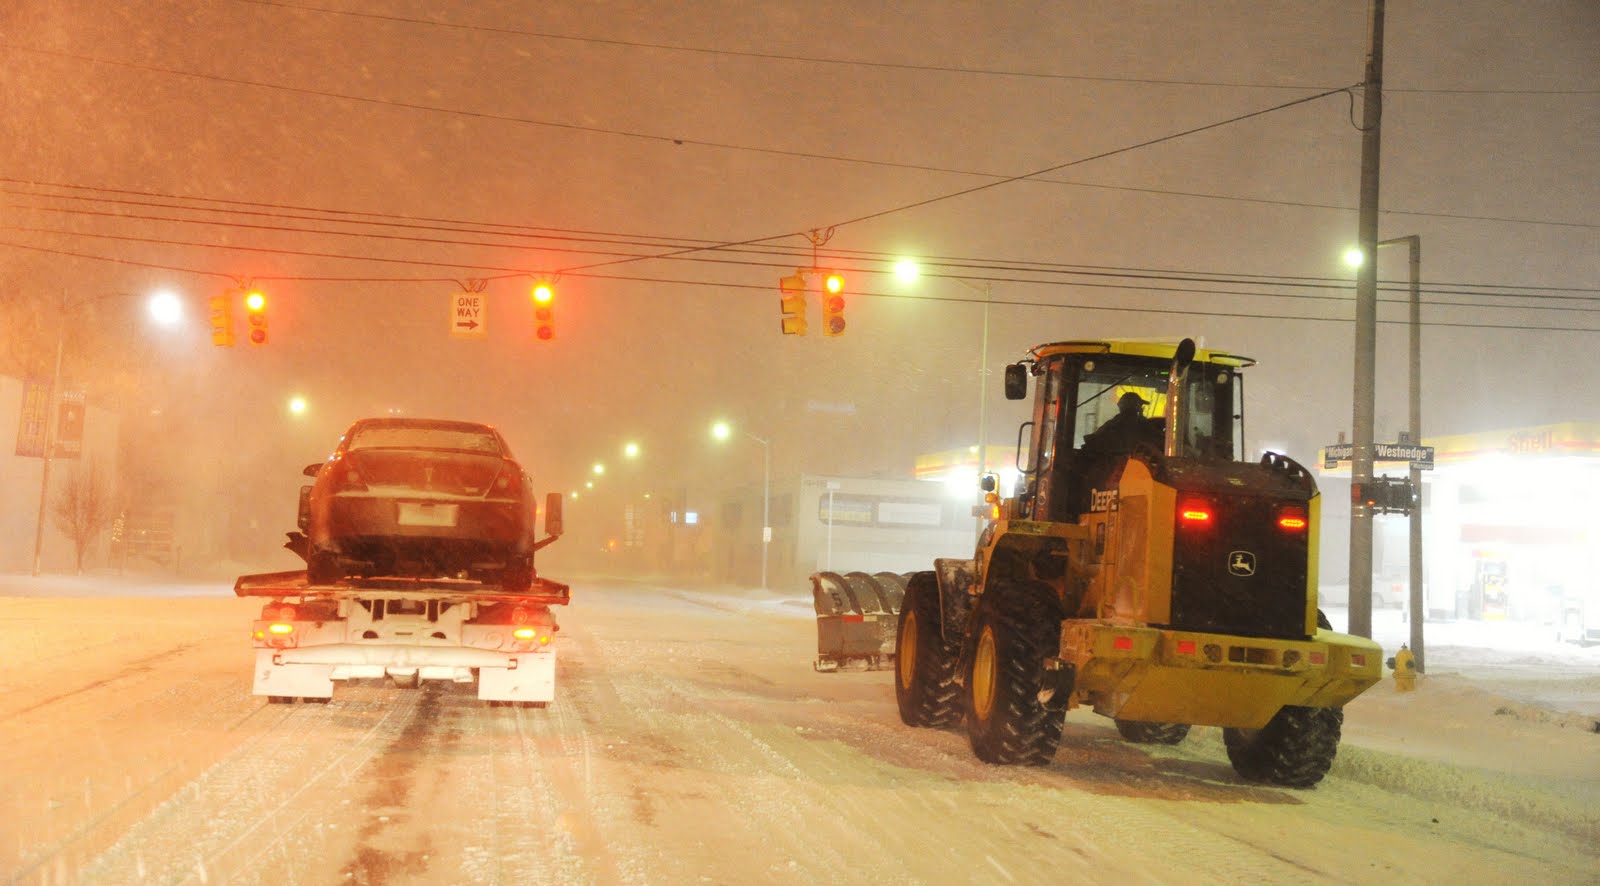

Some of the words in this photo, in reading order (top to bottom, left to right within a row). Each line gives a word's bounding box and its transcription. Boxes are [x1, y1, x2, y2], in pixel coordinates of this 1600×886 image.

[457, 297, 479, 307] ONE
[457, 308, 480, 317] WAY
[1328, 446, 1353, 460] Michigan
[1378, 445, 1427, 461] Westnedge
